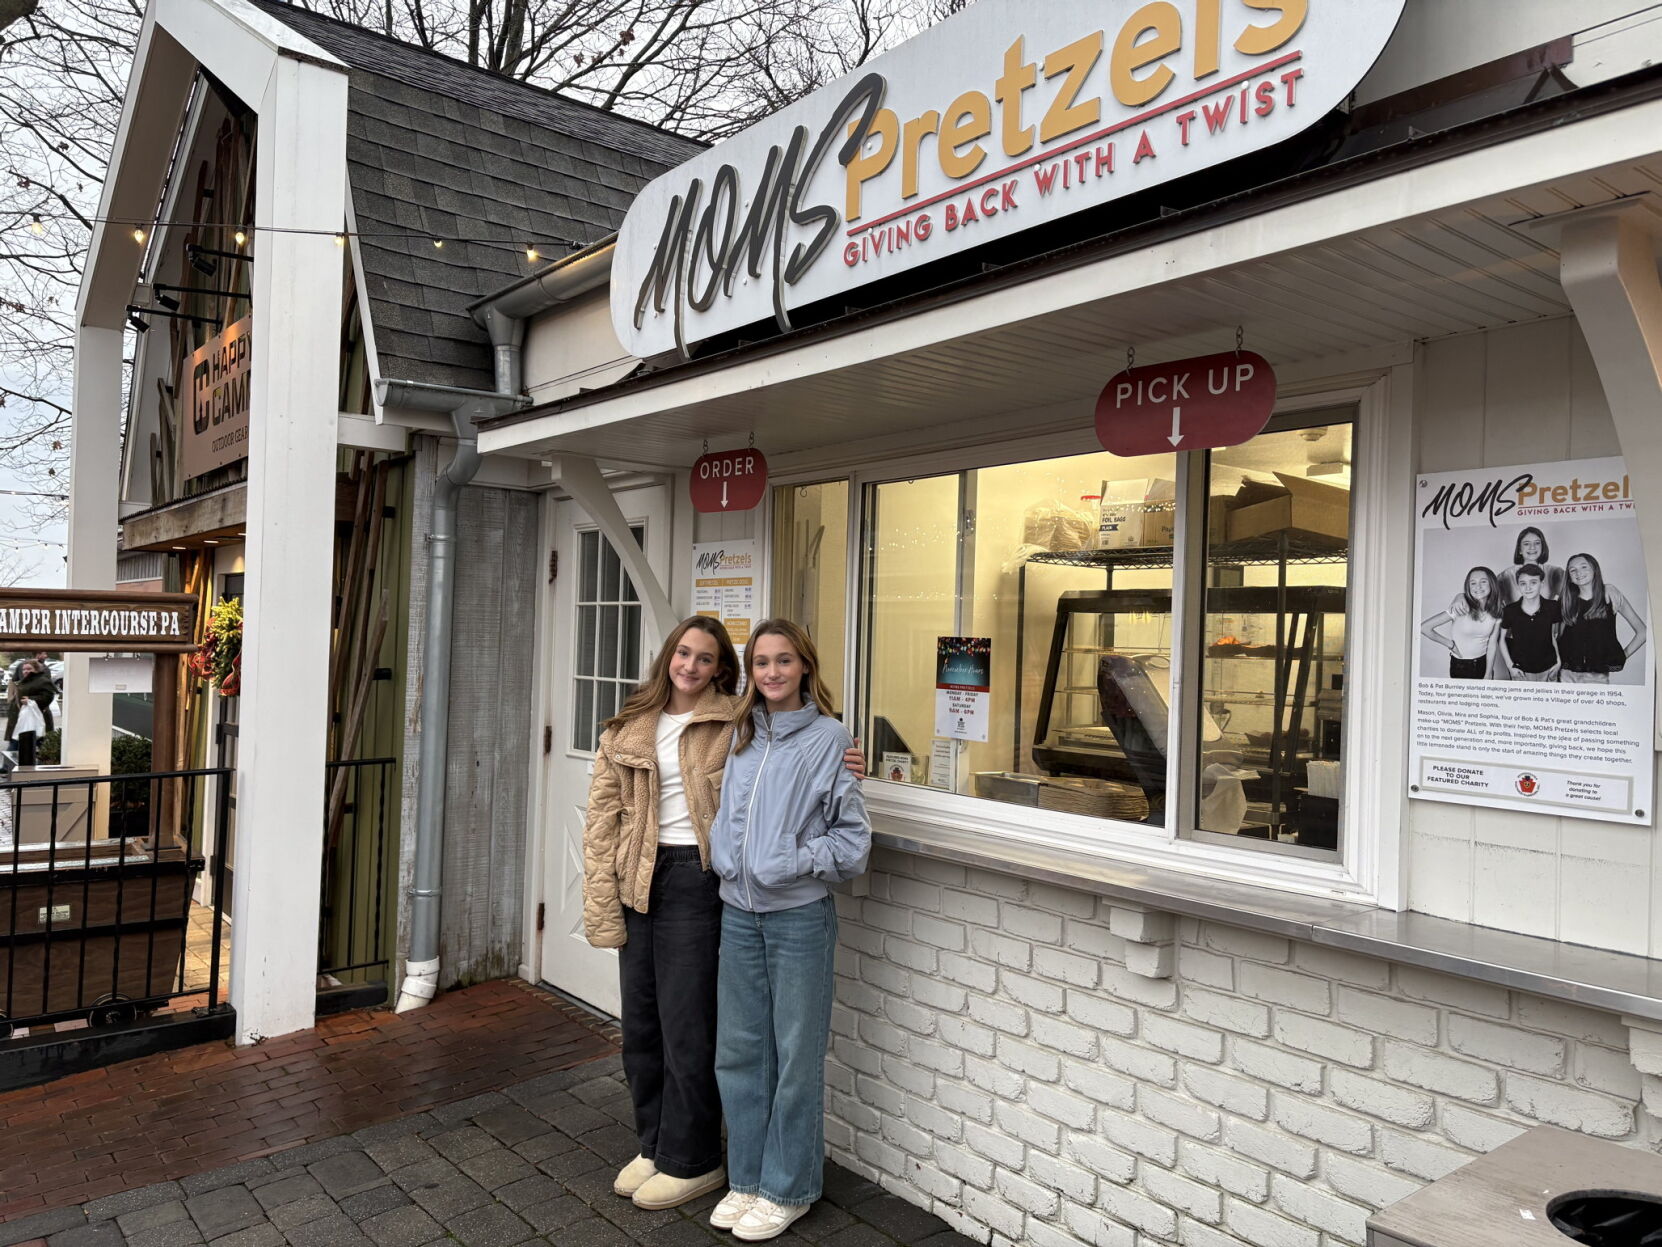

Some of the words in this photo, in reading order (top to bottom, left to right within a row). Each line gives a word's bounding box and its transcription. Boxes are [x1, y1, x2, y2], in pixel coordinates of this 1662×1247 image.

[634, 72, 888, 360] MOMS
[846, 0, 1310, 222] Pretzels
[844, 214, 933, 267] GIVING
[945, 179, 1018, 232] BACK
[1033, 142, 1116, 197] WITH
[1133, 129, 1156, 164] A
[1176, 68, 1304, 146] TWIST
[1116, 372, 1190, 408] PICK
[1208, 364, 1254, 395] UP
[212, 430, 234, 452] OUTDOOR
[700, 456, 754, 480] ORDER
[1422, 474, 1532, 530] MOMS
[1518, 474, 1630, 506] Pretzel
[1517, 508, 1550, 516] GIVING
[1554, 506, 1577, 514] BACK
[696, 550, 724, 575] MOMS
[720, 552, 752, 564] Pretzels
[54, 610, 157, 635] INTERCOURSE
[160, 612, 180, 636] PA
[1427, 776, 1459, 784] FEATURED
